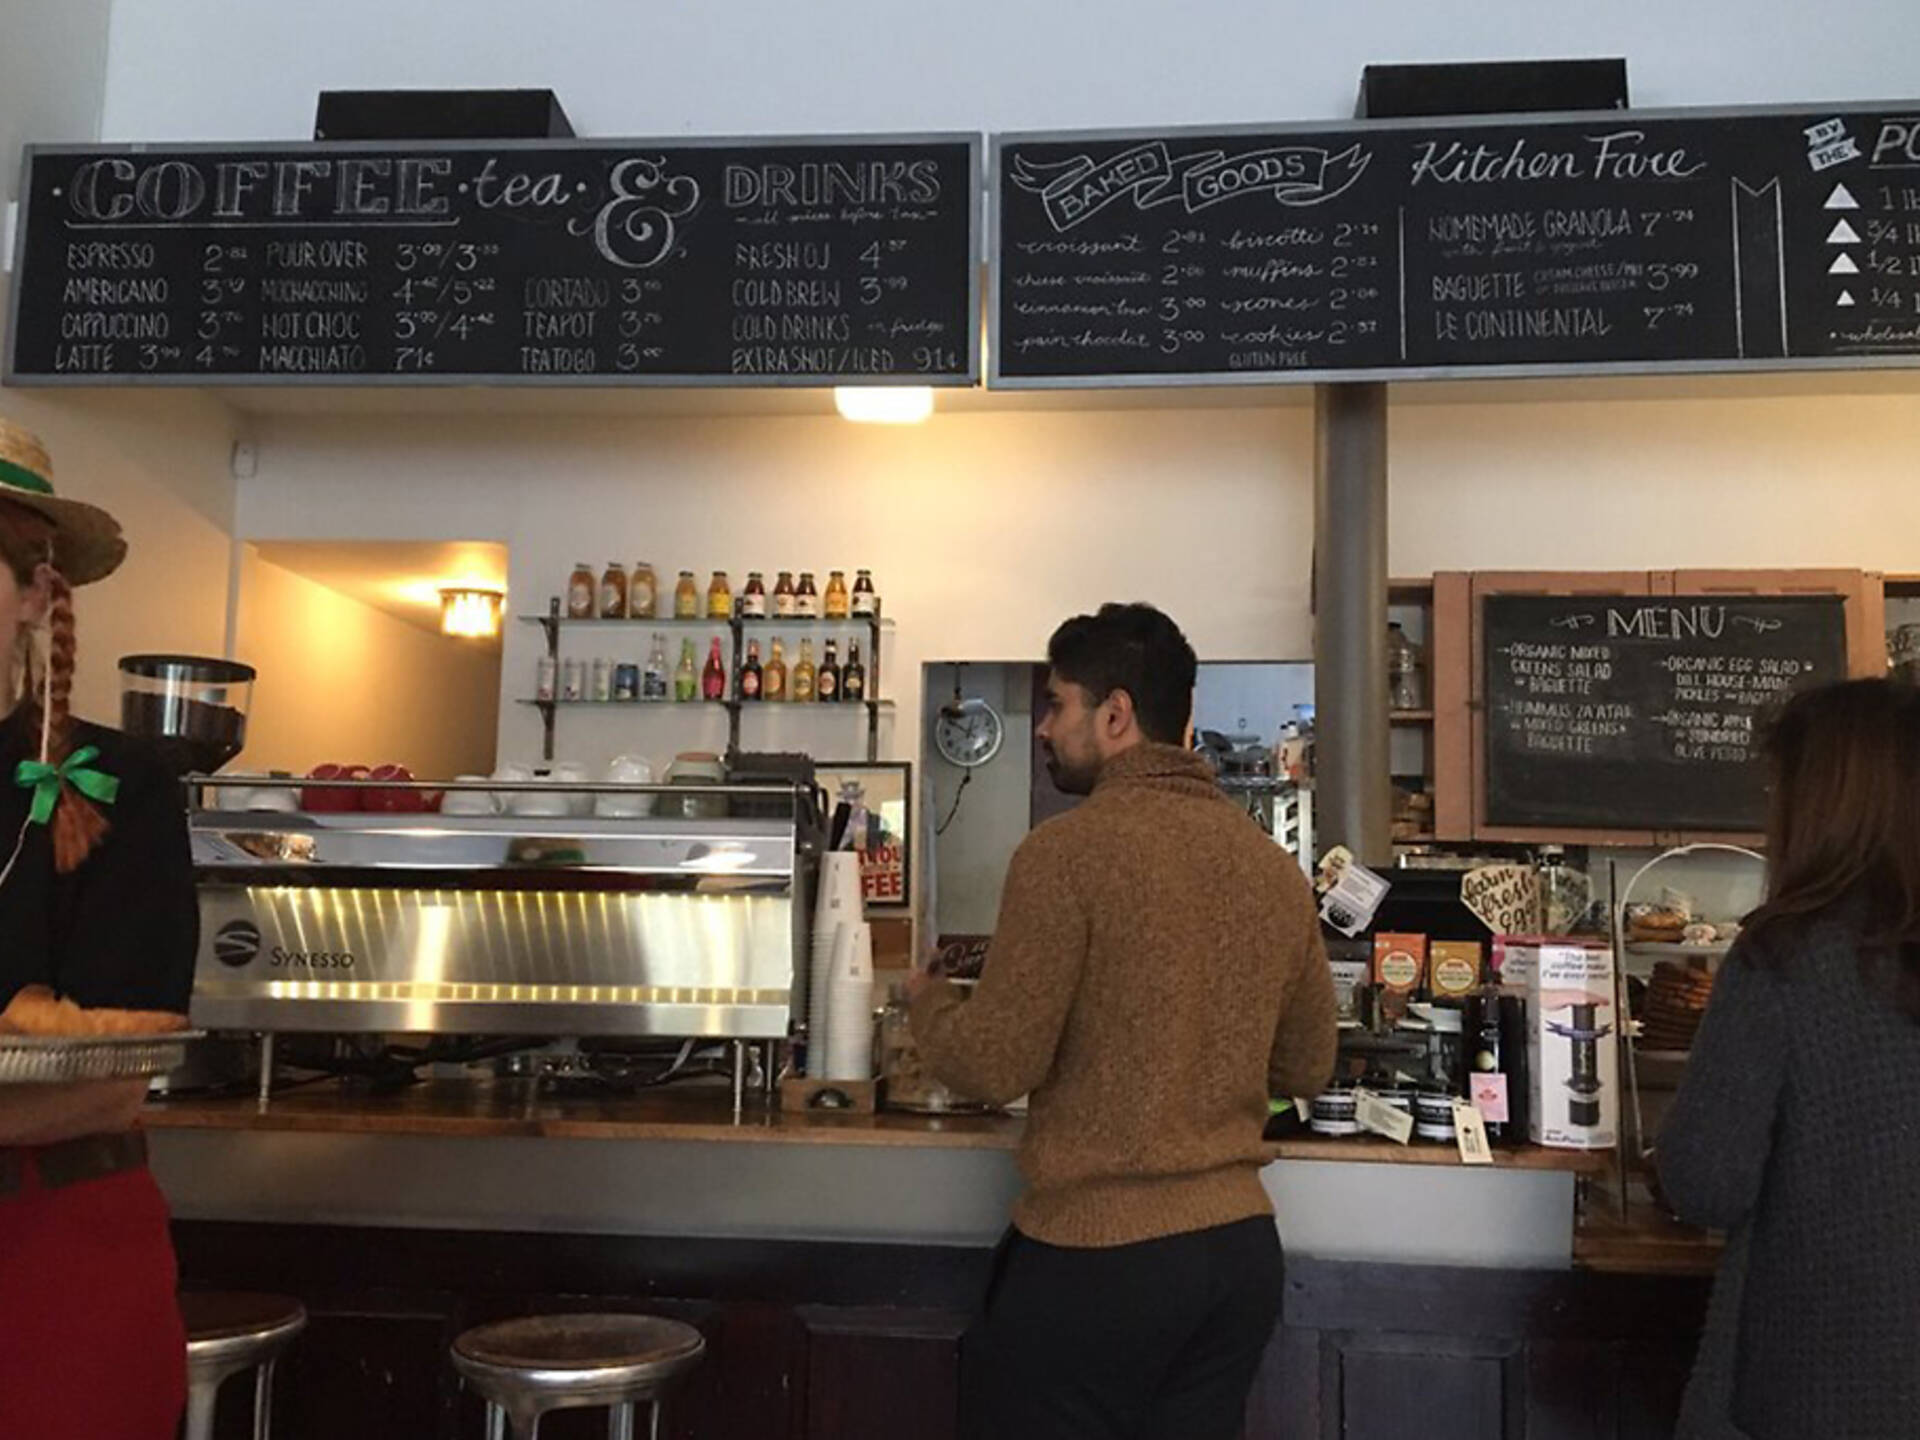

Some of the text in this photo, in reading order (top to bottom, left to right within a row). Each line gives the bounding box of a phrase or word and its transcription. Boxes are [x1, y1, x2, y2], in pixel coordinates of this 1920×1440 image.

[1815, 122, 1839, 138] BY
[1410, 130, 1708, 186] Kitchen Fare
[1816, 145, 1849, 165] THE
[725, 161, 941, 208] DRINKS
[1059, 152, 1306, 219] BAKED GOODS
[69, 154, 700, 269] COFFEE tea &
[1428, 212, 1536, 241] HOMEMADE
[1543, 207, 1633, 239] GRANOLA
[1016, 233, 1145, 256] croissant
[1220, 227, 1325, 250] biscotti
[66, 243, 155, 270] ESPRESSO
[266, 241, 317, 268] POUR
[319, 240, 369, 268] OVER
[735, 242, 799, 270] FRESH
[802, 242, 831, 270] OJ
[1223, 258, 1324, 283] muffins
[63, 279, 169, 305] AMERICANO
[524, 277, 610, 308] CORTADO
[731, 278, 783, 307] COLD
[785, 278, 841, 308] BREW
[1431, 272, 1526, 301] BAGUETTE
[1221, 297, 1320, 315] scones
[61, 311, 170, 340] CAPPUCCINO
[261, 310, 302, 339] HOT
[304, 310, 361, 339] CHOC
[522, 311, 596, 340] TEAPOT
[731, 313, 777, 342] COLD
[781, 313, 850, 342] DRINKS
[1220, 324, 1325, 347] cookies
[1435, 310, 1459, 341] LE
[1465, 307, 1612, 340] CONTINENTAL
[1013, 328, 1071, 355] pain
[53, 343, 115, 372] LATTE
[259, 345, 366, 373] MACCHIATO
[1606, 605, 1726, 640] MENU
[1509, 642, 1567, 660] ORGANIC
[1667, 655, 1725, 671] ORGANIC
[1728, 657, 1754, 673] EGG
[1566, 662, 1613, 680] SALAD
[861, 872, 902, 897] FEE
